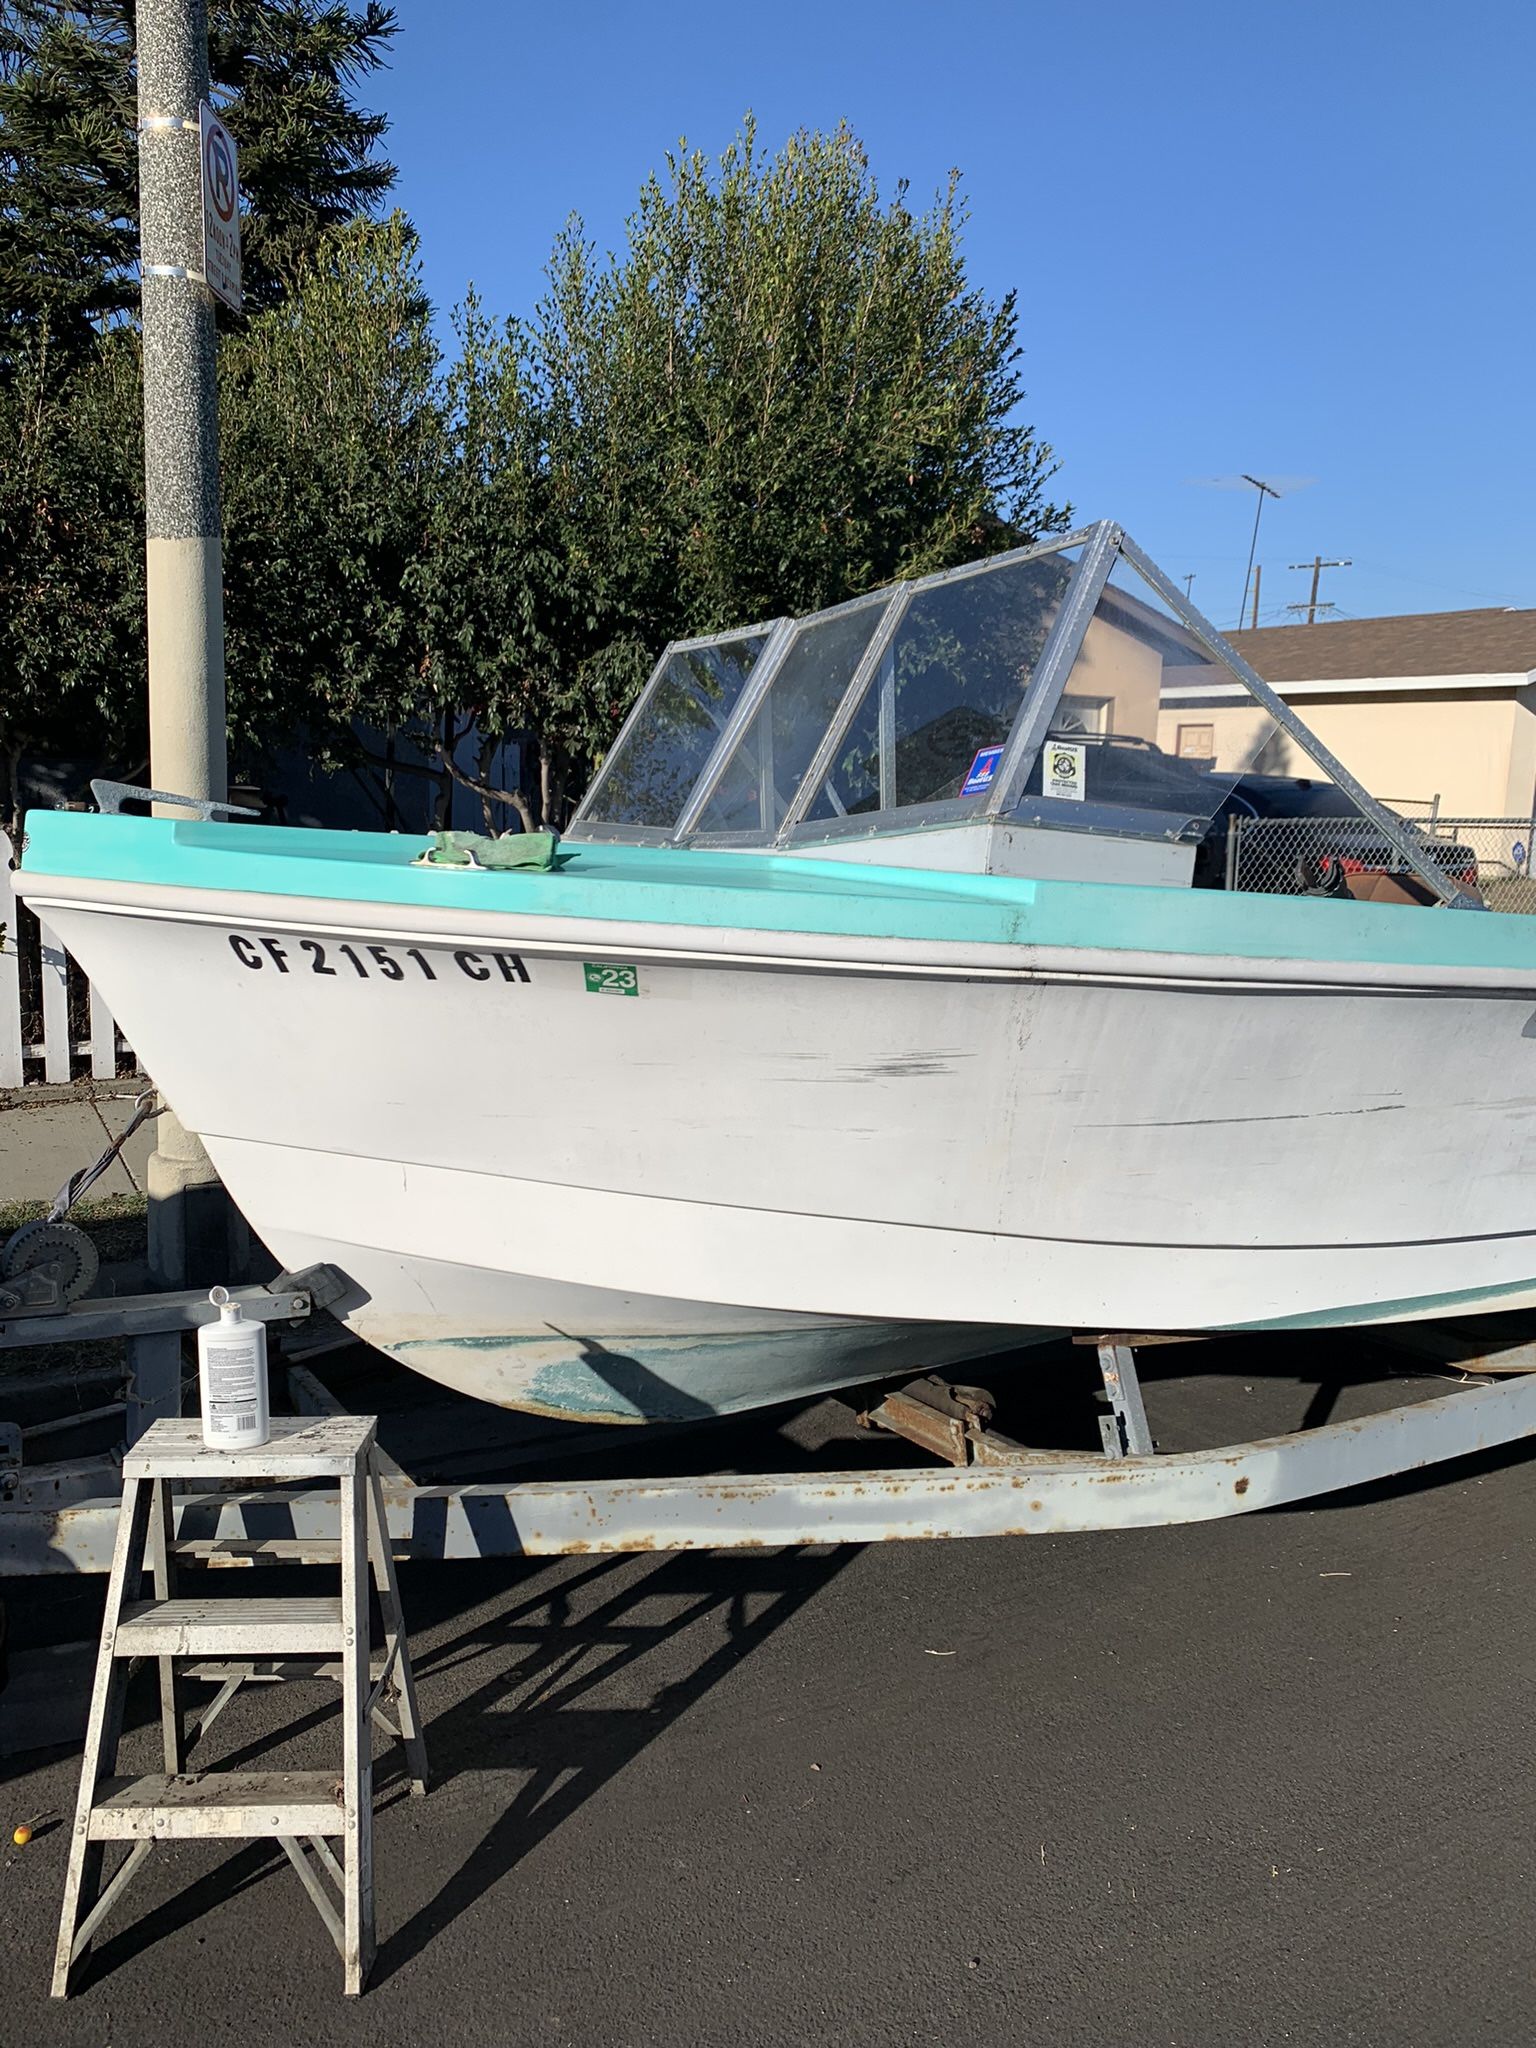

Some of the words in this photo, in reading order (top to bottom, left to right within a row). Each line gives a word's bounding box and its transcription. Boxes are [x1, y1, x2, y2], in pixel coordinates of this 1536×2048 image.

[228, 934, 290, 973] CF
[299, 939, 438, 981] 2151
[453, 950, 532, 983] CH
[601, 969, 636, 988] 23
